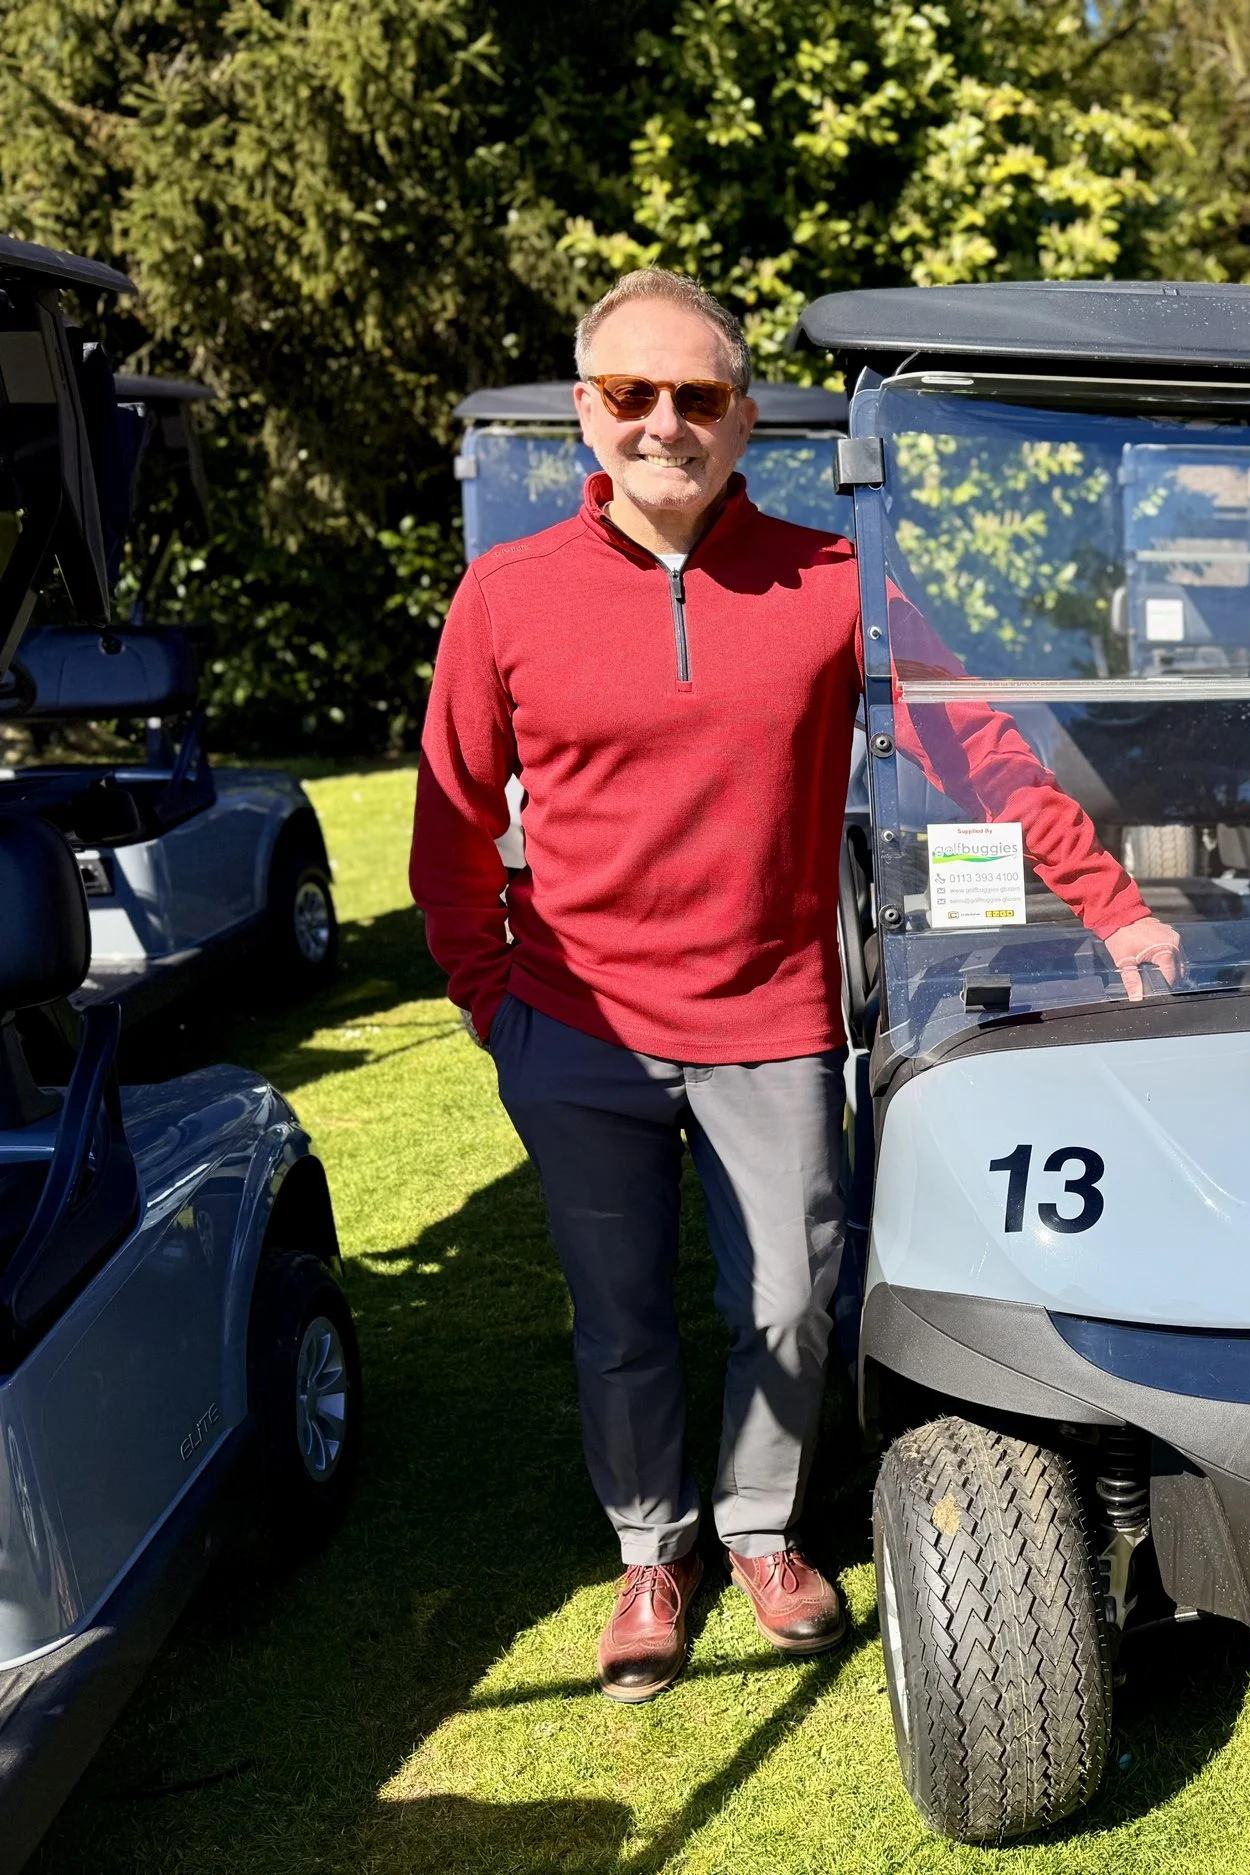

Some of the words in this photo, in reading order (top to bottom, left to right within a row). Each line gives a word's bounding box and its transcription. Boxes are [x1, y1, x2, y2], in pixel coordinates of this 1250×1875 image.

[934, 842, 1018, 857] golfbuggies
[949, 873, 972, 883] 0113
[975, 873, 994, 882] 393
[995, 872, 1019, 881] 4100
[989, 1144, 1105, 1234] 13
